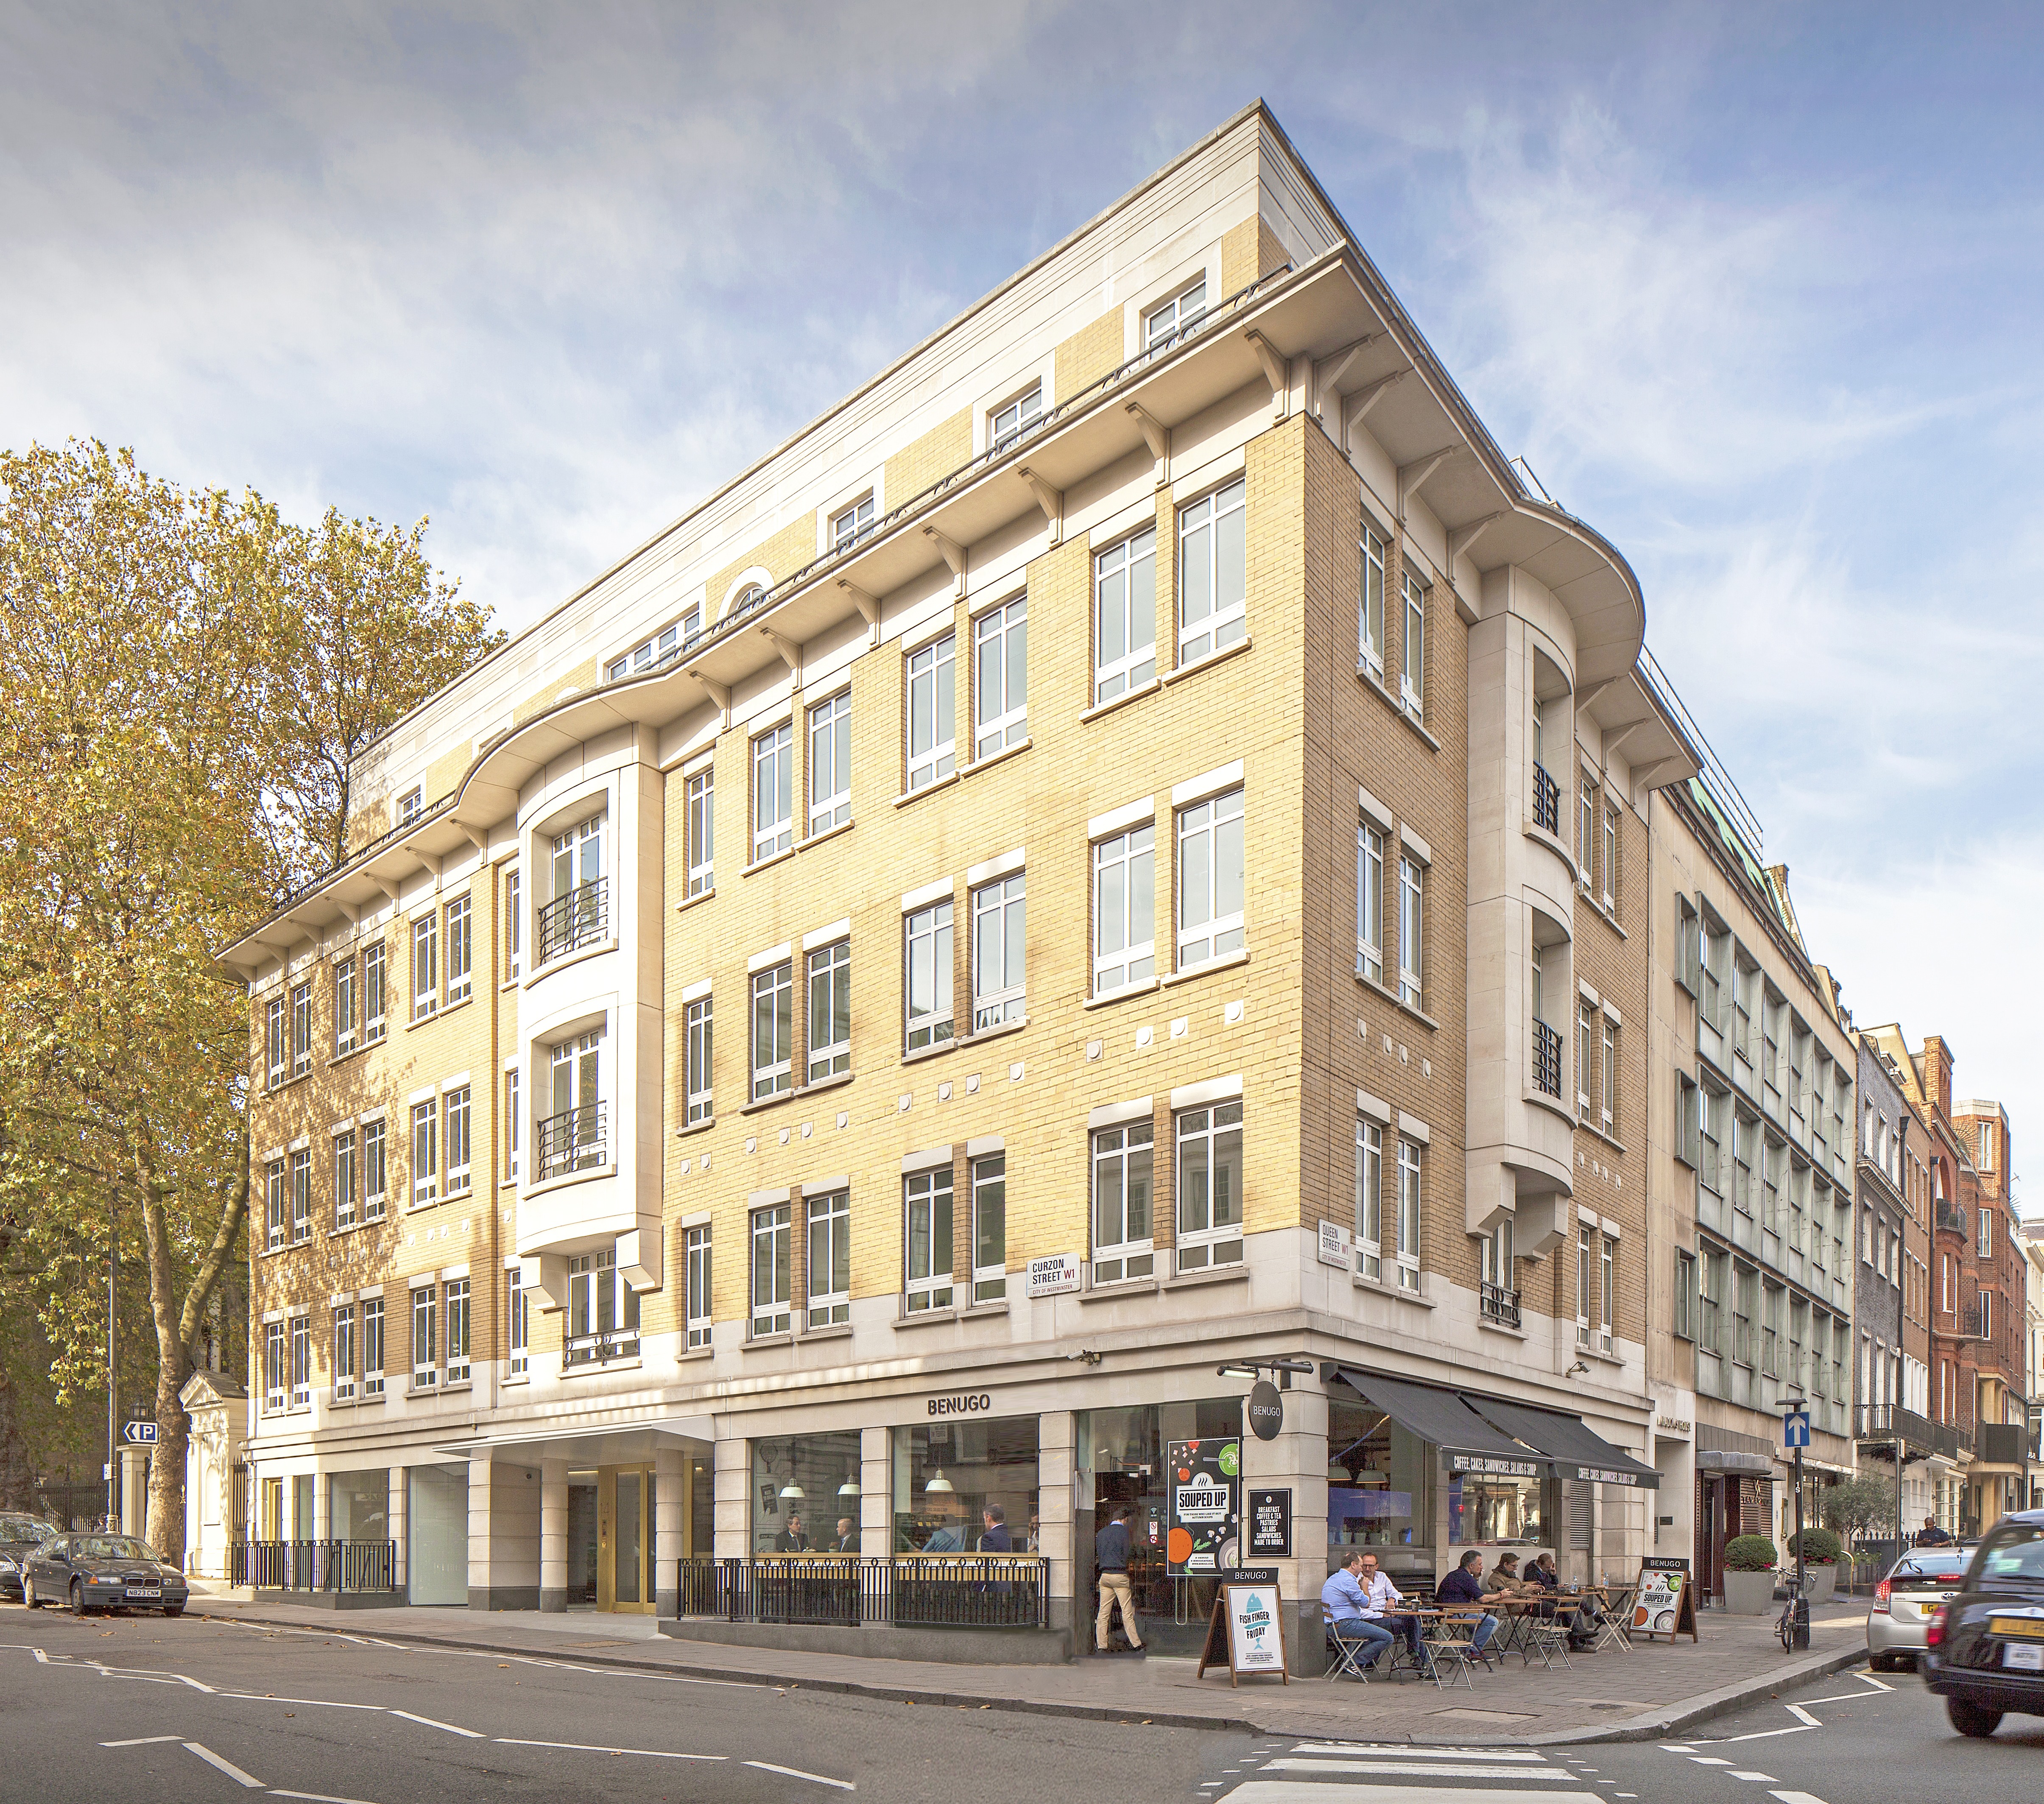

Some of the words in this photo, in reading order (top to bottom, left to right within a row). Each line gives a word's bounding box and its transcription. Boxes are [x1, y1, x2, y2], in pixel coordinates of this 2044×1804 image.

[1323, 1224, 1338, 1239] QUEEN
[1322, 1237, 1340, 1252] STREET
[1342, 1243, 1348, 1255] W1
[1033, 1258, 1064, 1273] CURZON
[1331, 1257, 1346, 1266] WESTMINSTER
[1033, 1271, 1061, 1285] STREET
[1064, 1268, 1075, 1279] W1
[1047, 1284, 1072, 1292] WESTMINSTER
[928, 1394, 990, 1415] BENUGO
[1253, 1405, 1281, 1416] BENUGO
[143, 1425, 153, 1439] P
[1454, 1455, 1470, 1472] COFFEE,
[1471, 1457, 1485, 1472] CAKES,
[1485, 1459, 1510, 1475] SANDWICHES,
[1510, 1461, 1524, 1475] SALADS
[1527, 1463, 1536, 1476] SOUP
[1179, 1492, 1212, 1508] SOUPED
[1215, 1491, 1226, 1506] UP
[1644, 1594, 1664, 1603] SOUPED
[1664, 1595, 1673, 1603] UP
[1239, 1614, 1251, 1624] FISH
[1251, 1611, 1270, 1622] FINGER
[1246, 1627, 1265, 1639] FRIDAY
